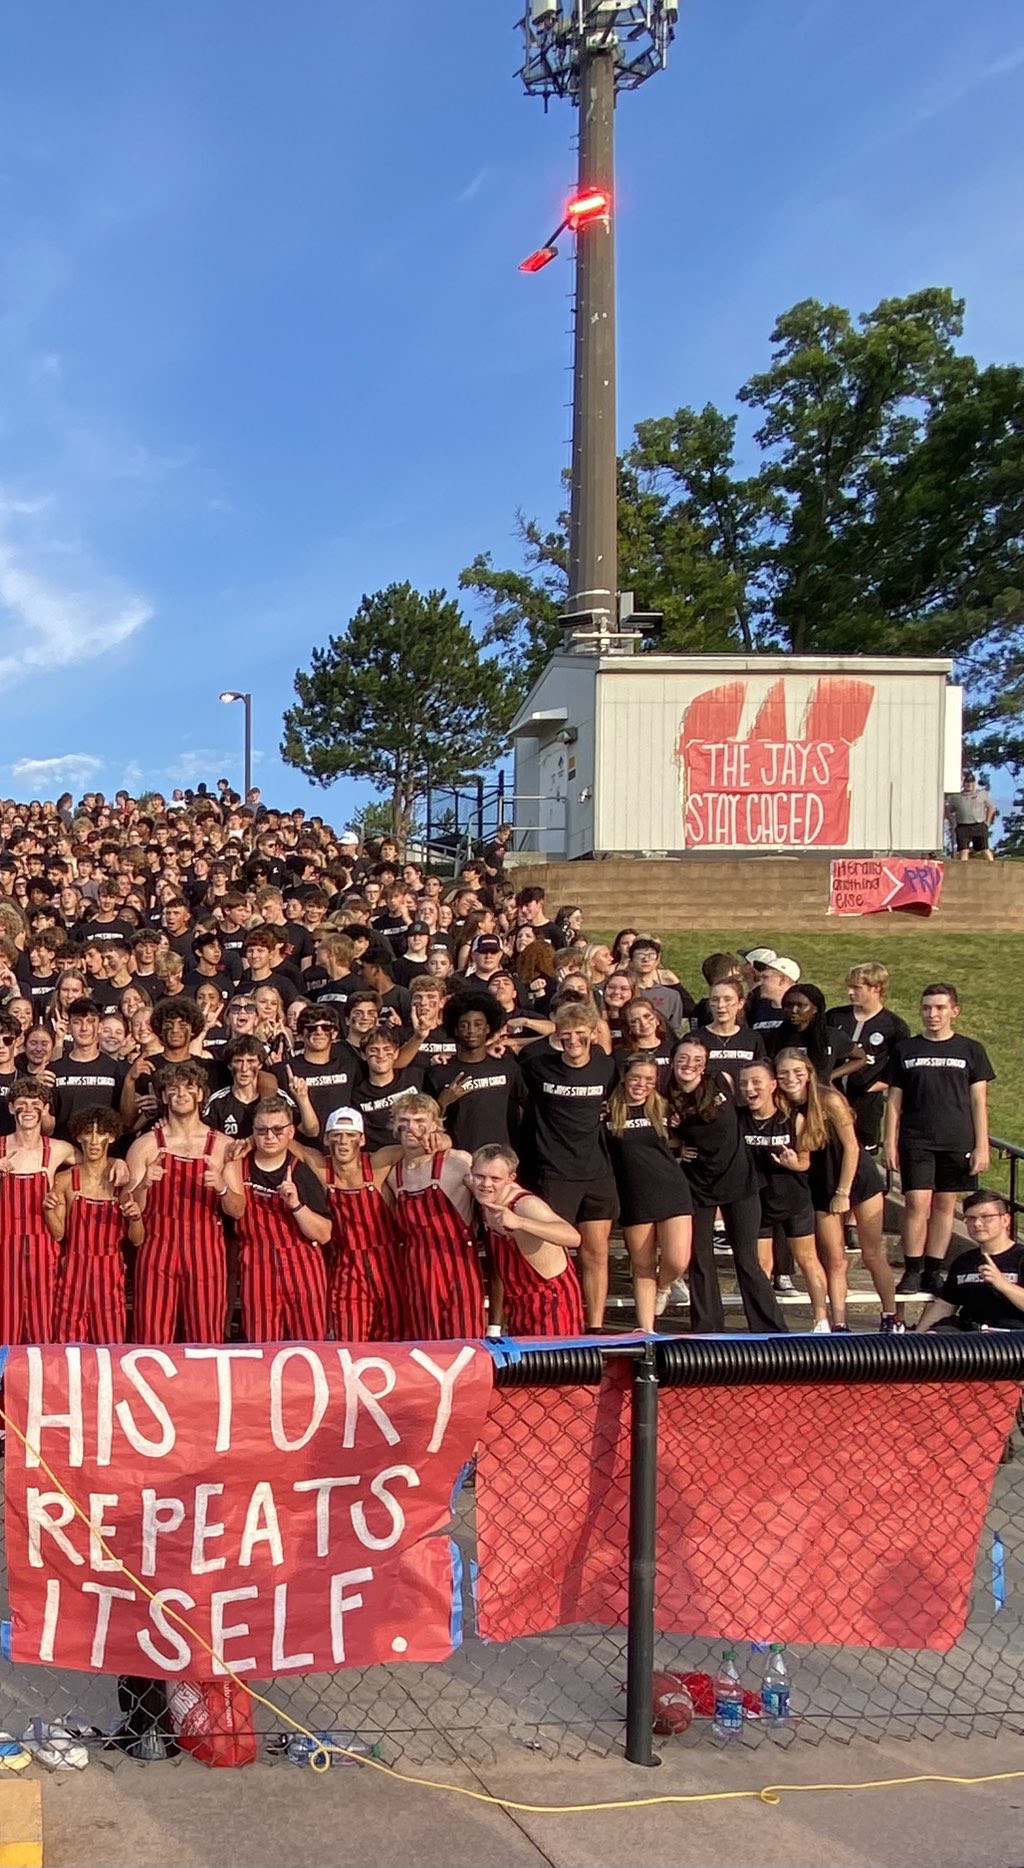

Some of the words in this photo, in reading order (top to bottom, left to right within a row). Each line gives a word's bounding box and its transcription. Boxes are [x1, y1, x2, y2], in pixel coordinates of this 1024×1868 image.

[701, 742, 751, 787] THE
[760, 742, 835, 786] JAYS
[685, 793, 741, 845] STAY
[746, 790, 824, 845] CAGED
[835, 893, 864, 908] else
[224, 1123, 239, 1135] 20
[25, 1345, 477, 1468] HISTORY
[26, 1464, 421, 1576] REPEATS
[39, 1566, 408, 1676] ITSELF.
